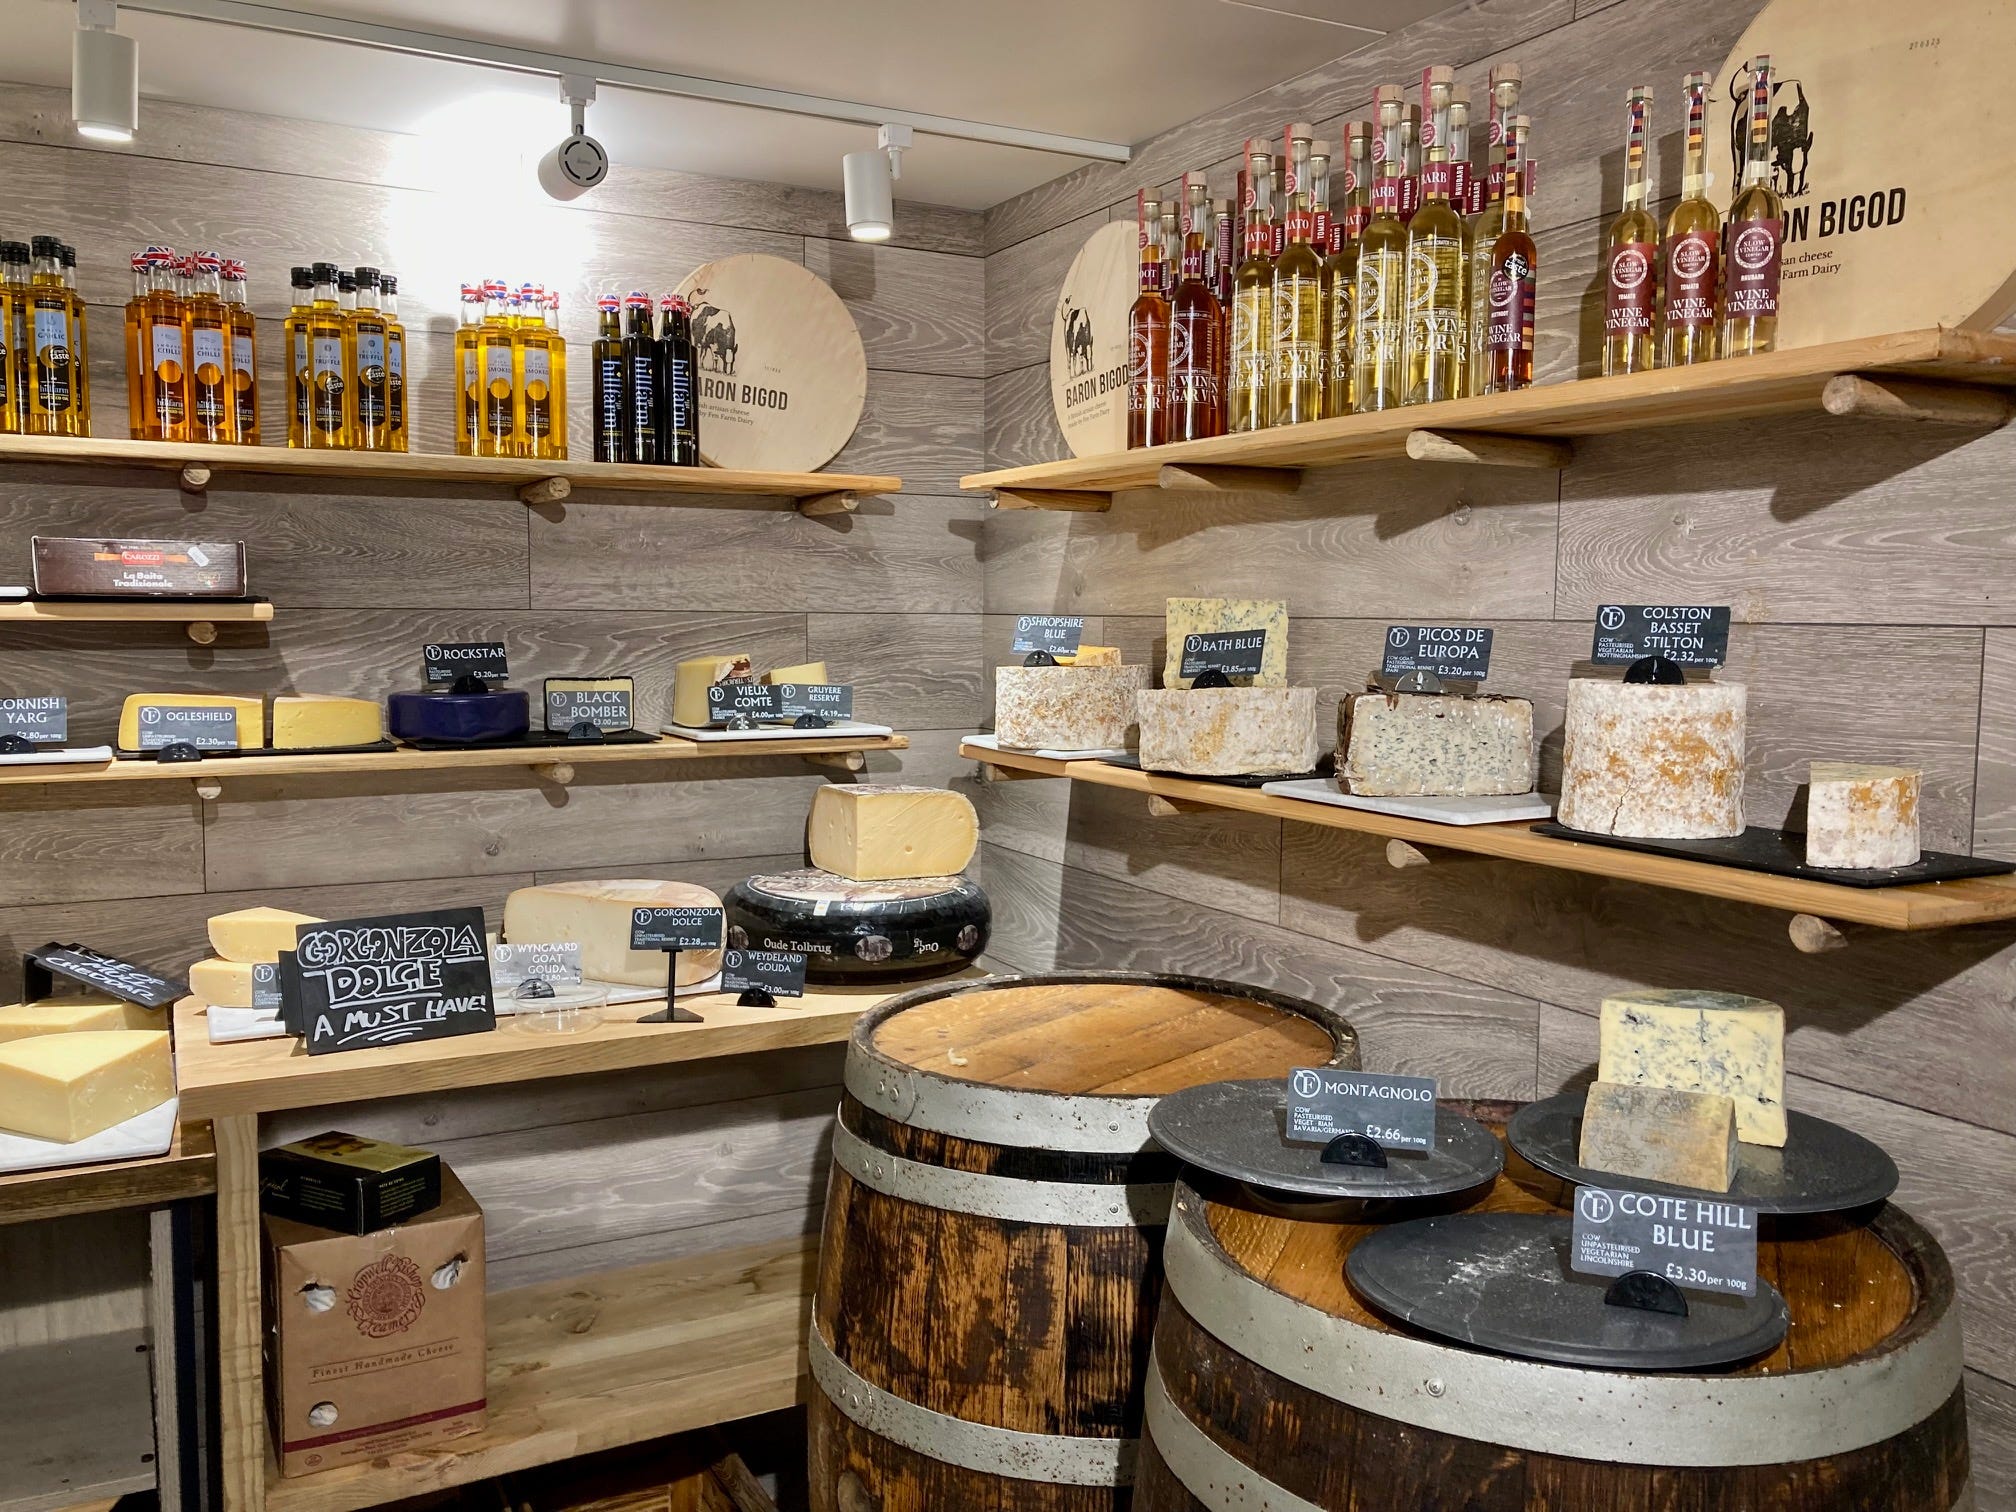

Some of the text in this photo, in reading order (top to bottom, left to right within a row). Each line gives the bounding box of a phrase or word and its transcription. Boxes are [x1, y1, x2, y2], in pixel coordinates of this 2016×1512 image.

[1819, 187, 1907, 239] BIGOD
[1739, 245, 1770, 253] VINEGAR
[1677, 255, 1706, 263] VINEGAR
[1799, 250, 1833, 264] cheese
[1782, 263, 1842, 280] Farm Dairy
[1734, 288, 1770, 300] WINE
[1673, 298, 1706, 309] WINE
[1727, 298, 1776, 312] VINEGAR
[1611, 307, 1643, 318] WINE
[1666, 308, 1713, 321] VINEGAR
[1605, 317, 1649, 329] VINEGAR
[50, 351, 70, 360] taste
[197, 350, 221, 358] CHILLI
[635, 357, 653, 426] hillfarm
[1066, 364, 1129, 409] BARON BIGOD
[603, 360, 622, 428] hillfarm
[672, 359, 690, 427] hillfarm
[741, 384, 788, 410] BIGOD
[124, 572, 163, 580] La Baita
[113, 579, 173, 588] Tradizionale
[1642, 607, 1711, 620] COLSTON
[1031, 616, 1084, 628] SHROPSHIRE
[1650, 622, 1701, 634] BASSET
[1044, 629, 1067, 638] BLUE
[1418, 628, 1485, 642] PICOS DE
[1202, 637, 1262, 652] BATH BLUE
[1643, 636, 1704, 649] STILTON
[443, 647, 506, 660] ROCKSTAR
[1418, 644, 1480, 659] EUROPA
[1663, 650, 1694, 661] £2.32
[1438, 665, 1462, 675] £3.20
[736, 686, 769, 696] VIEUX
[808, 686, 842, 694] GRUYERE
[576, 691, 621, 703] BLACK
[735, 697, 773, 707] COMTE
[809, 694, 840, 702] RESERVE
[6, 712, 47, 724] YARG
[166, 712, 233, 721] OGLESHIELD
[571, 706, 627, 718] BOMBER
[196, 737, 218, 745] £2.30
[654, 908, 721, 917] GORGONZOLA
[672, 918, 702, 926] DOLCE
[297, 924, 482, 969] GORGONZOLA
[679, 937, 701, 946] £2.28
[764, 938, 832, 954] Oude Tolbrug
[517, 943, 578, 953] WYNGAARD
[532, 954, 563, 963] GOAT
[748, 952, 802, 963] WEYDELAND
[65, 946, 165, 986] ISLE OF
[528, 964, 567, 974] GOUDA
[757, 963, 791, 973] GOUDA
[45, 957, 154, 1001] CHEDDAR
[326, 958, 443, 1003] DOLCE
[313, 995, 487, 1042] A MUST HAVE!
[1325, 1081, 1432, 1102] MONTAGNOLO
[1294, 1113, 1333, 1121] PASTEURISED
[1294, 1119, 1334, 1127] VEGETRIAN
[1366, 1124, 1400, 1140] £2.66
[1413, 1137, 1427, 1145] 100g
[1619, 1193, 1687, 1221] COTE
[1696, 1203, 1751, 1230] HILL
[1653, 1224, 1715, 1252] BLUE
[1581, 1240, 1641, 1254] UNPASTEURISED
[1581, 1247, 1630, 1259] VEGETARIAN
[1580, 1254, 1635, 1268] LINCOLNSHIRE
[1666, 1263, 1747, 1290] £3.30 per 100g
[313, 1343, 455, 1378] Finest Handmade Cheese
